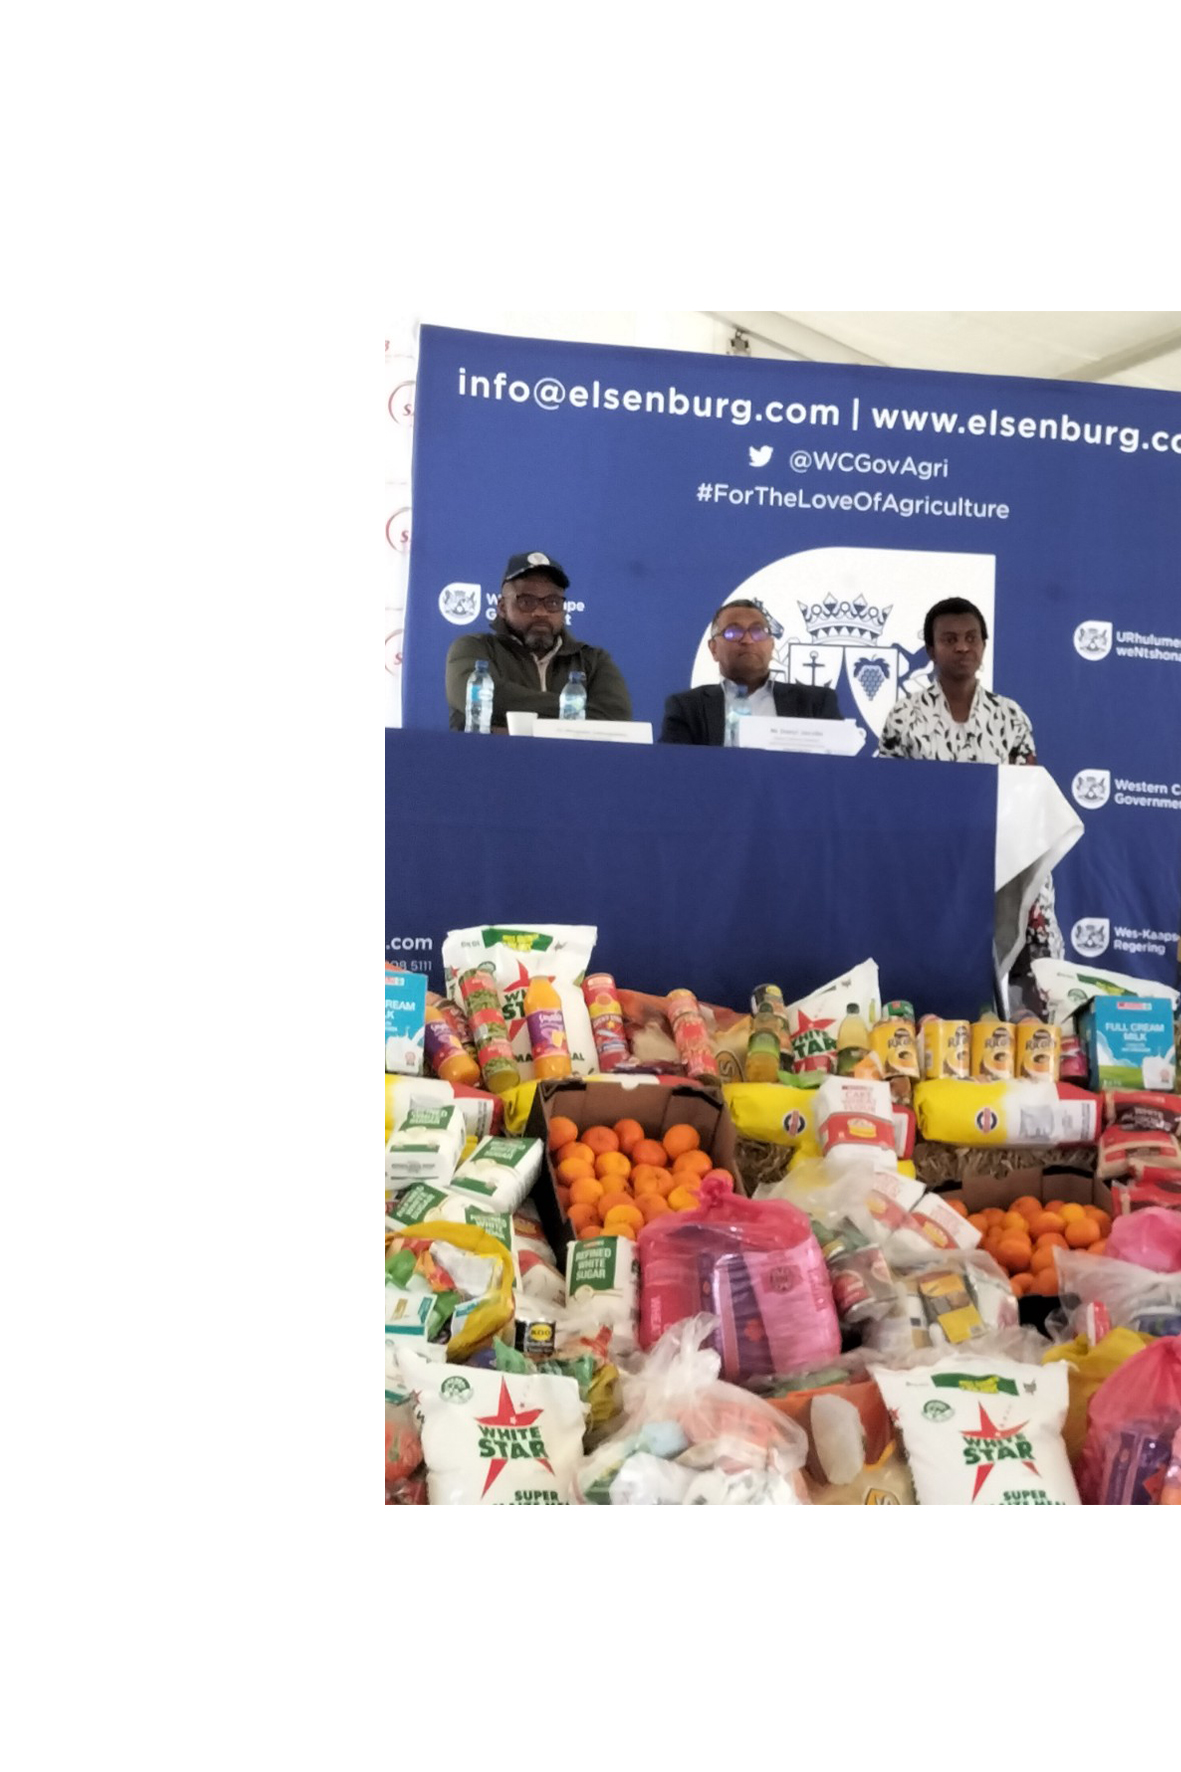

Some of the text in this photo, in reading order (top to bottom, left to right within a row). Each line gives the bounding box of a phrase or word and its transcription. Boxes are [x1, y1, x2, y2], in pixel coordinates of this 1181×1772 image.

[457, 368, 840, 426] info@elsenburg.com
[789, 449, 949, 479] @WCGovAgri
[697, 483, 1011, 519] #ForTheLoveOfAgriculture
[1114, 778, 1168, 796] Western
[1113, 939, 1166, 956] Regering
[411, 961, 432, 971] 5111
[385, 999, 416, 1011] REAM
[1105, 1022, 1165, 1033] FULL CREAM
[1123, 1032, 1147, 1041] MILK
[792, 1039, 838, 1059] TAR
[575, 1249, 612, 1261] REFINED
[578, 1258, 606, 1270] WHITE
[575, 1268, 606, 1281] SUGAR
[530, 1328, 552, 1337] KOO
[478, 1425, 543, 1441] WHITE
[963, 1432, 1027, 1449] WHITE
[478, 1439, 549, 1460] STAR
[963, 1440, 1036, 1465] STAR
[514, 1489, 560, 1502] SUPER
[1002, 1489, 1047, 1502] SUPER
